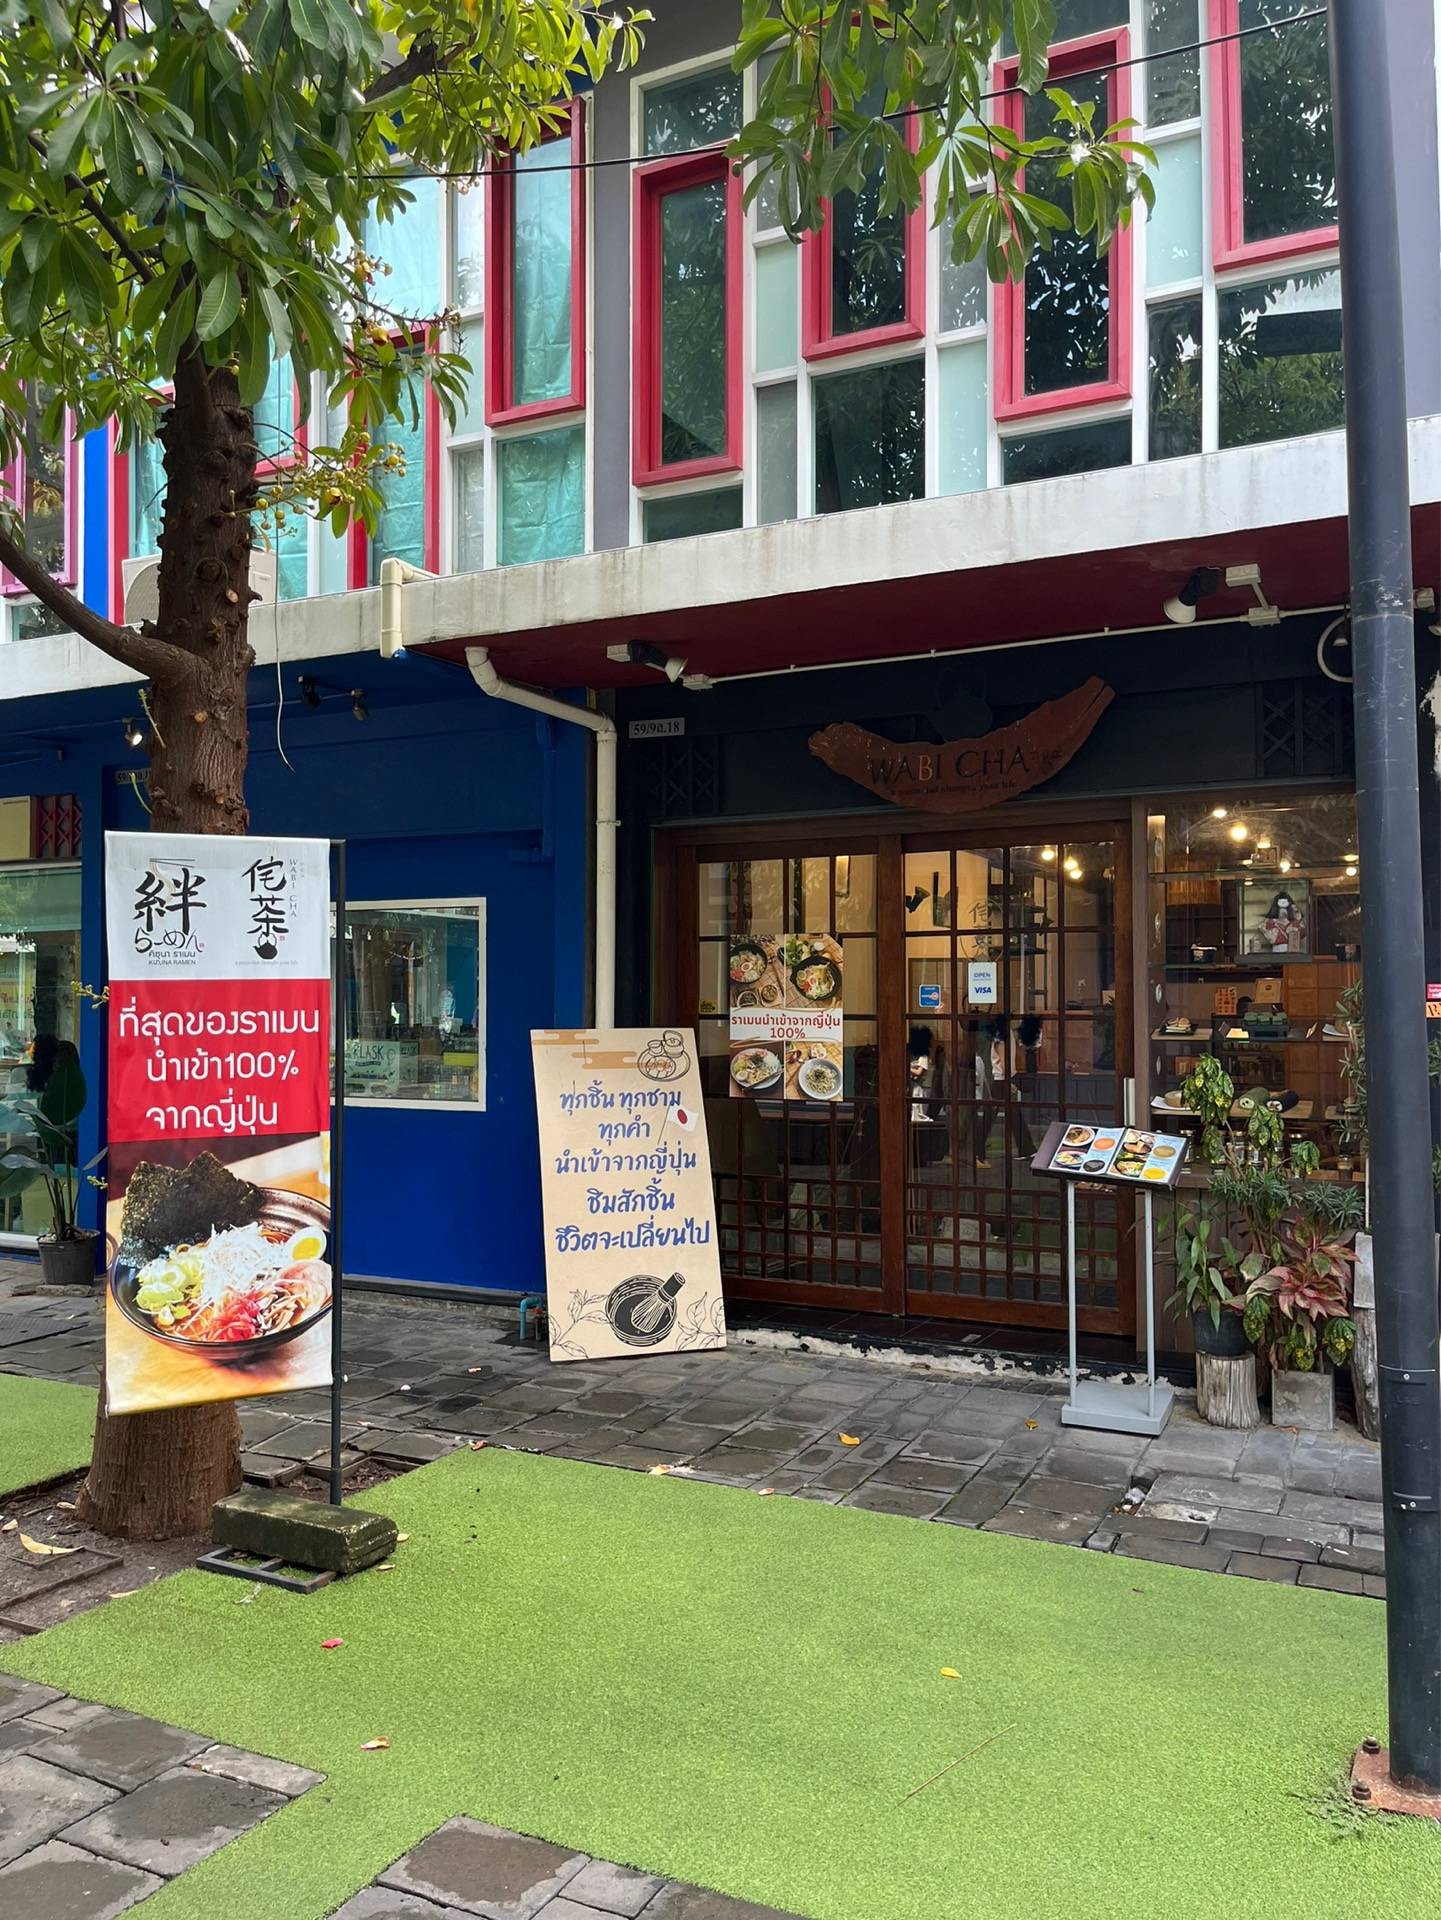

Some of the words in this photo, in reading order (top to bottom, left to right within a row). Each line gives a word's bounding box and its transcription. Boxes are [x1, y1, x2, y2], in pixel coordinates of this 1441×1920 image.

[871, 753, 942, 786] WABI
[955, 745, 1030, 777] CHA
[133, 868, 208, 935] 絆
[289, 895, 298, 917] CHA
[134, 926, 203, 953] らーめん
[119, 996, 320, 1044] ที่สุดของราเมน
[731, 1011, 841, 1029] ราเมนนำเข้าจากญี่ปุ่น
[770, 1027, 806, 1039] 100%
[147, 1048, 299, 1082] นำเข้า100%
[145, 1088, 278, 1135] จากญี่ปุ่น
[560, 1080, 615, 1116] ทุกชิ้น
[620, 1088, 681, 1114] ทุกชาม
[598, 1115, 651, 1145] ทุกคำ
[555, 1141, 696, 1177] นำเข้าจากญี่ปุ่น
[587, 1178, 675, 1214] ชิมสักชิ้น
[555, 1215, 711, 1253] ชีวิตจะเปลี่ยนไป
